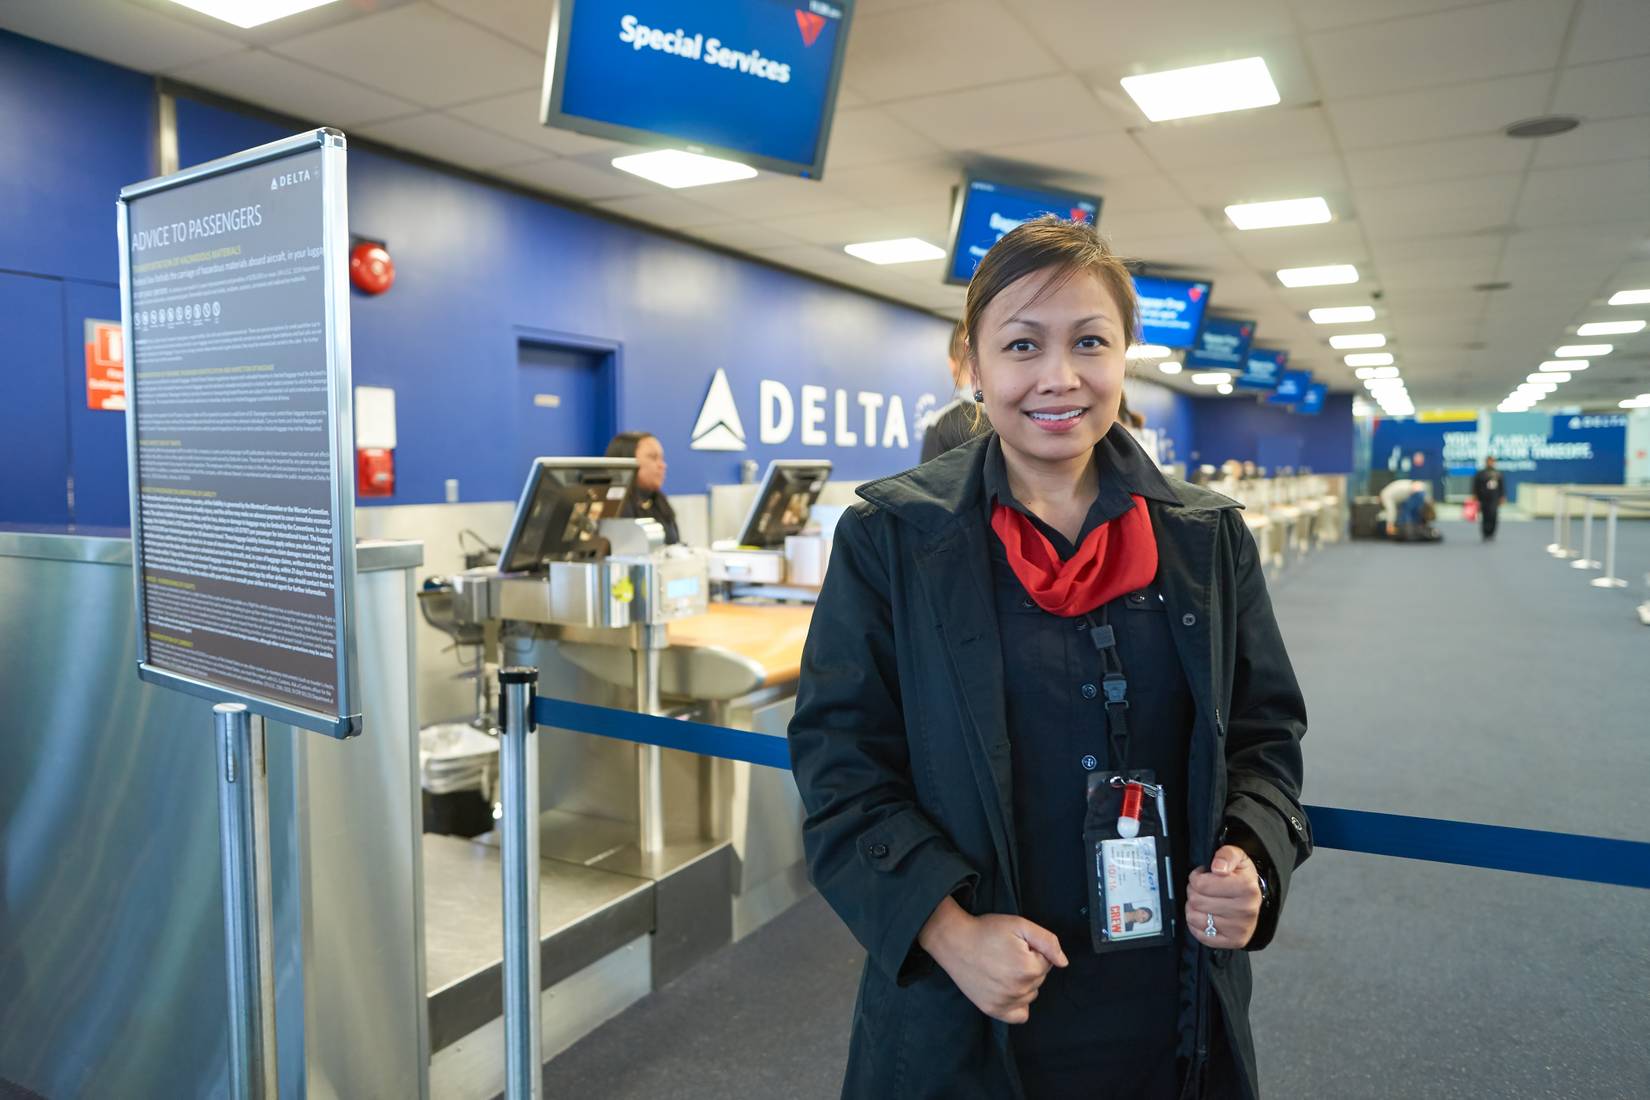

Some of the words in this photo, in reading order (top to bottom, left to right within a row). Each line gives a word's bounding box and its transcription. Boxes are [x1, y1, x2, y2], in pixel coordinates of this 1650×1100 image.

[619, 14, 703, 60] Special
[704, 37, 791, 84] Services
[279, 169, 311, 187] DELTA
[132, 225, 170, 252] ADVICE
[171, 222, 187, 243] TO
[188, 204, 262, 240] PASSENGERS
[759, 379, 909, 448] DELTA
[1110, 905, 1121, 932] CREW
